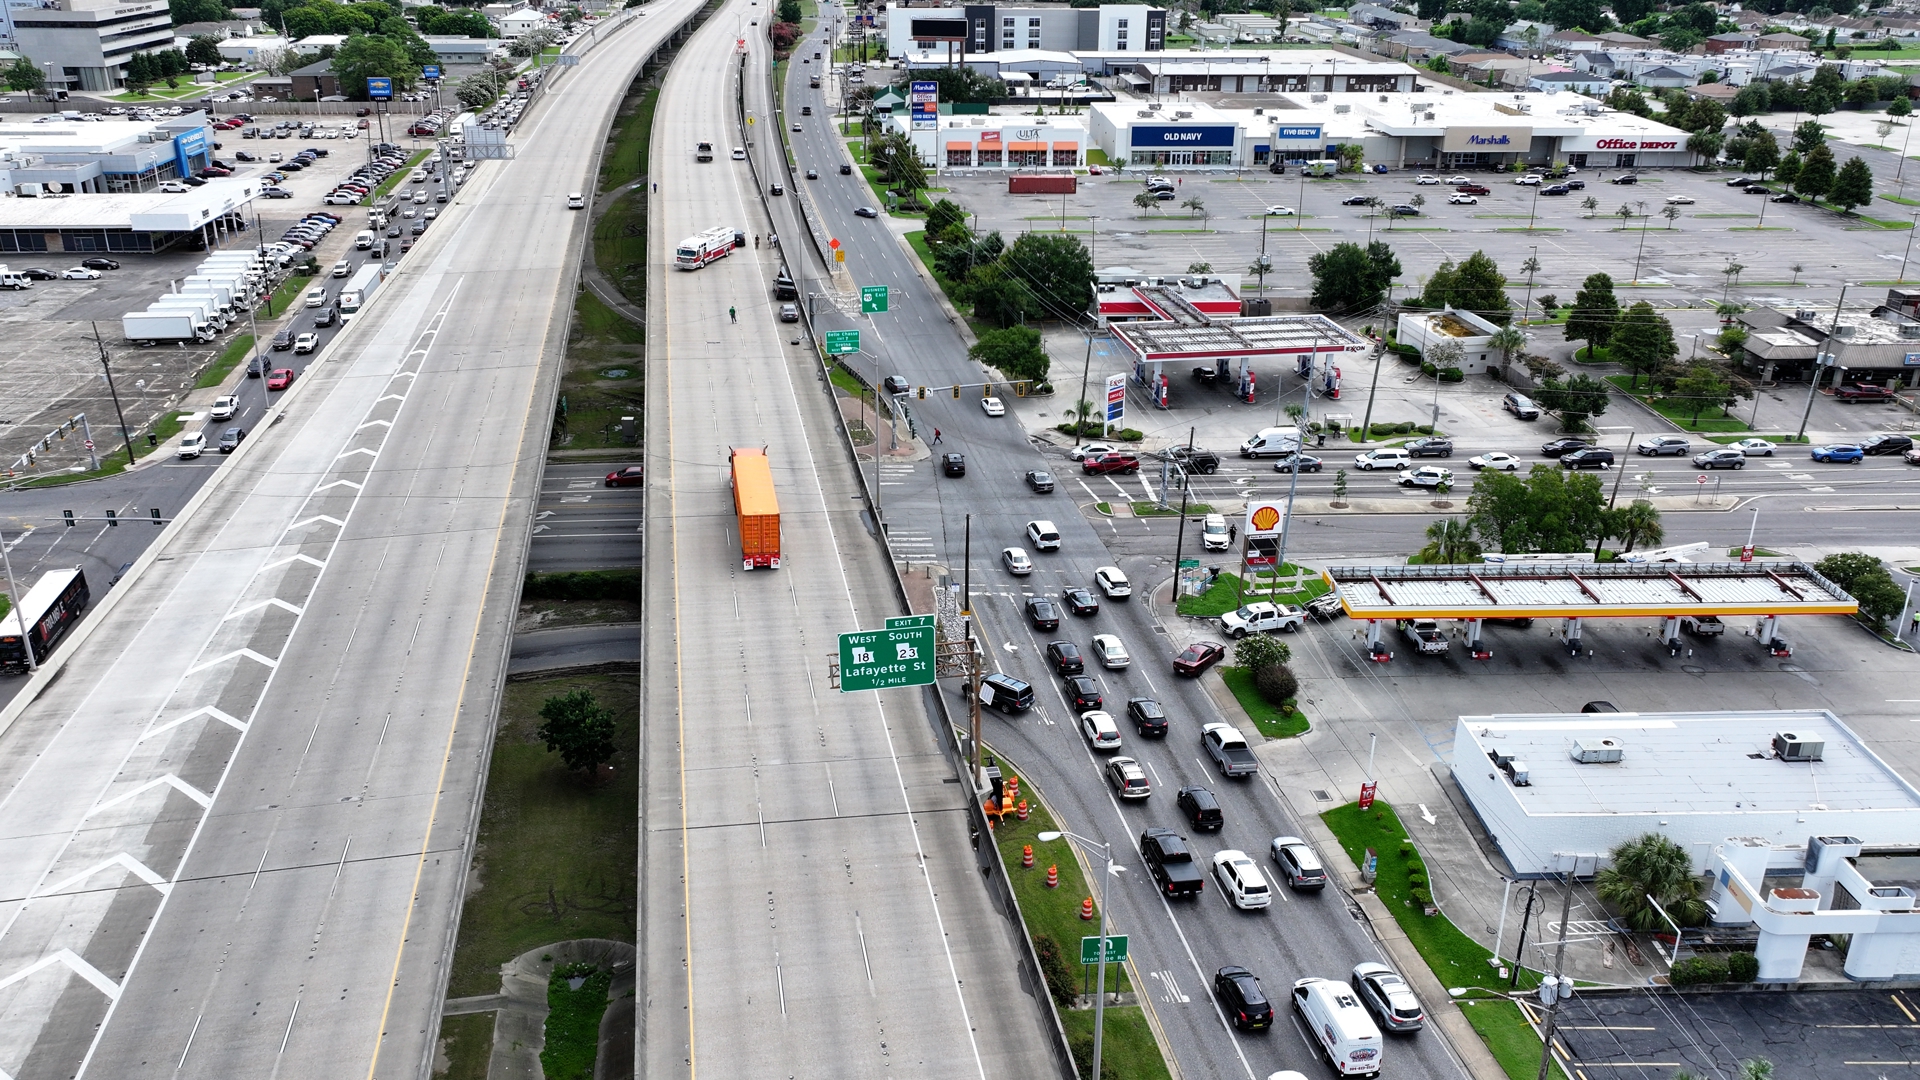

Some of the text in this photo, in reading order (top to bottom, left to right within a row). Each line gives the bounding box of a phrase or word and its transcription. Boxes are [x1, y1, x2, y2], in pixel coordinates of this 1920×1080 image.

[1164, 132, 1202, 141] OLD NAVY
[1466, 134, 1511, 145] Marshalls
[1596, 138, 1678, 149] Office DEPOT
[1346, 344, 1366, 353] EXXON
[1110, 378, 1125, 386] Exxon
[895, 617, 925, 627] EXIT 7
[848, 631, 922, 644] WEST SOUTH
[857, 648, 916, 662] 18 23
[846, 661, 926, 677] Lafayette St
[871, 676, 907, 686] 1/2 MILE
